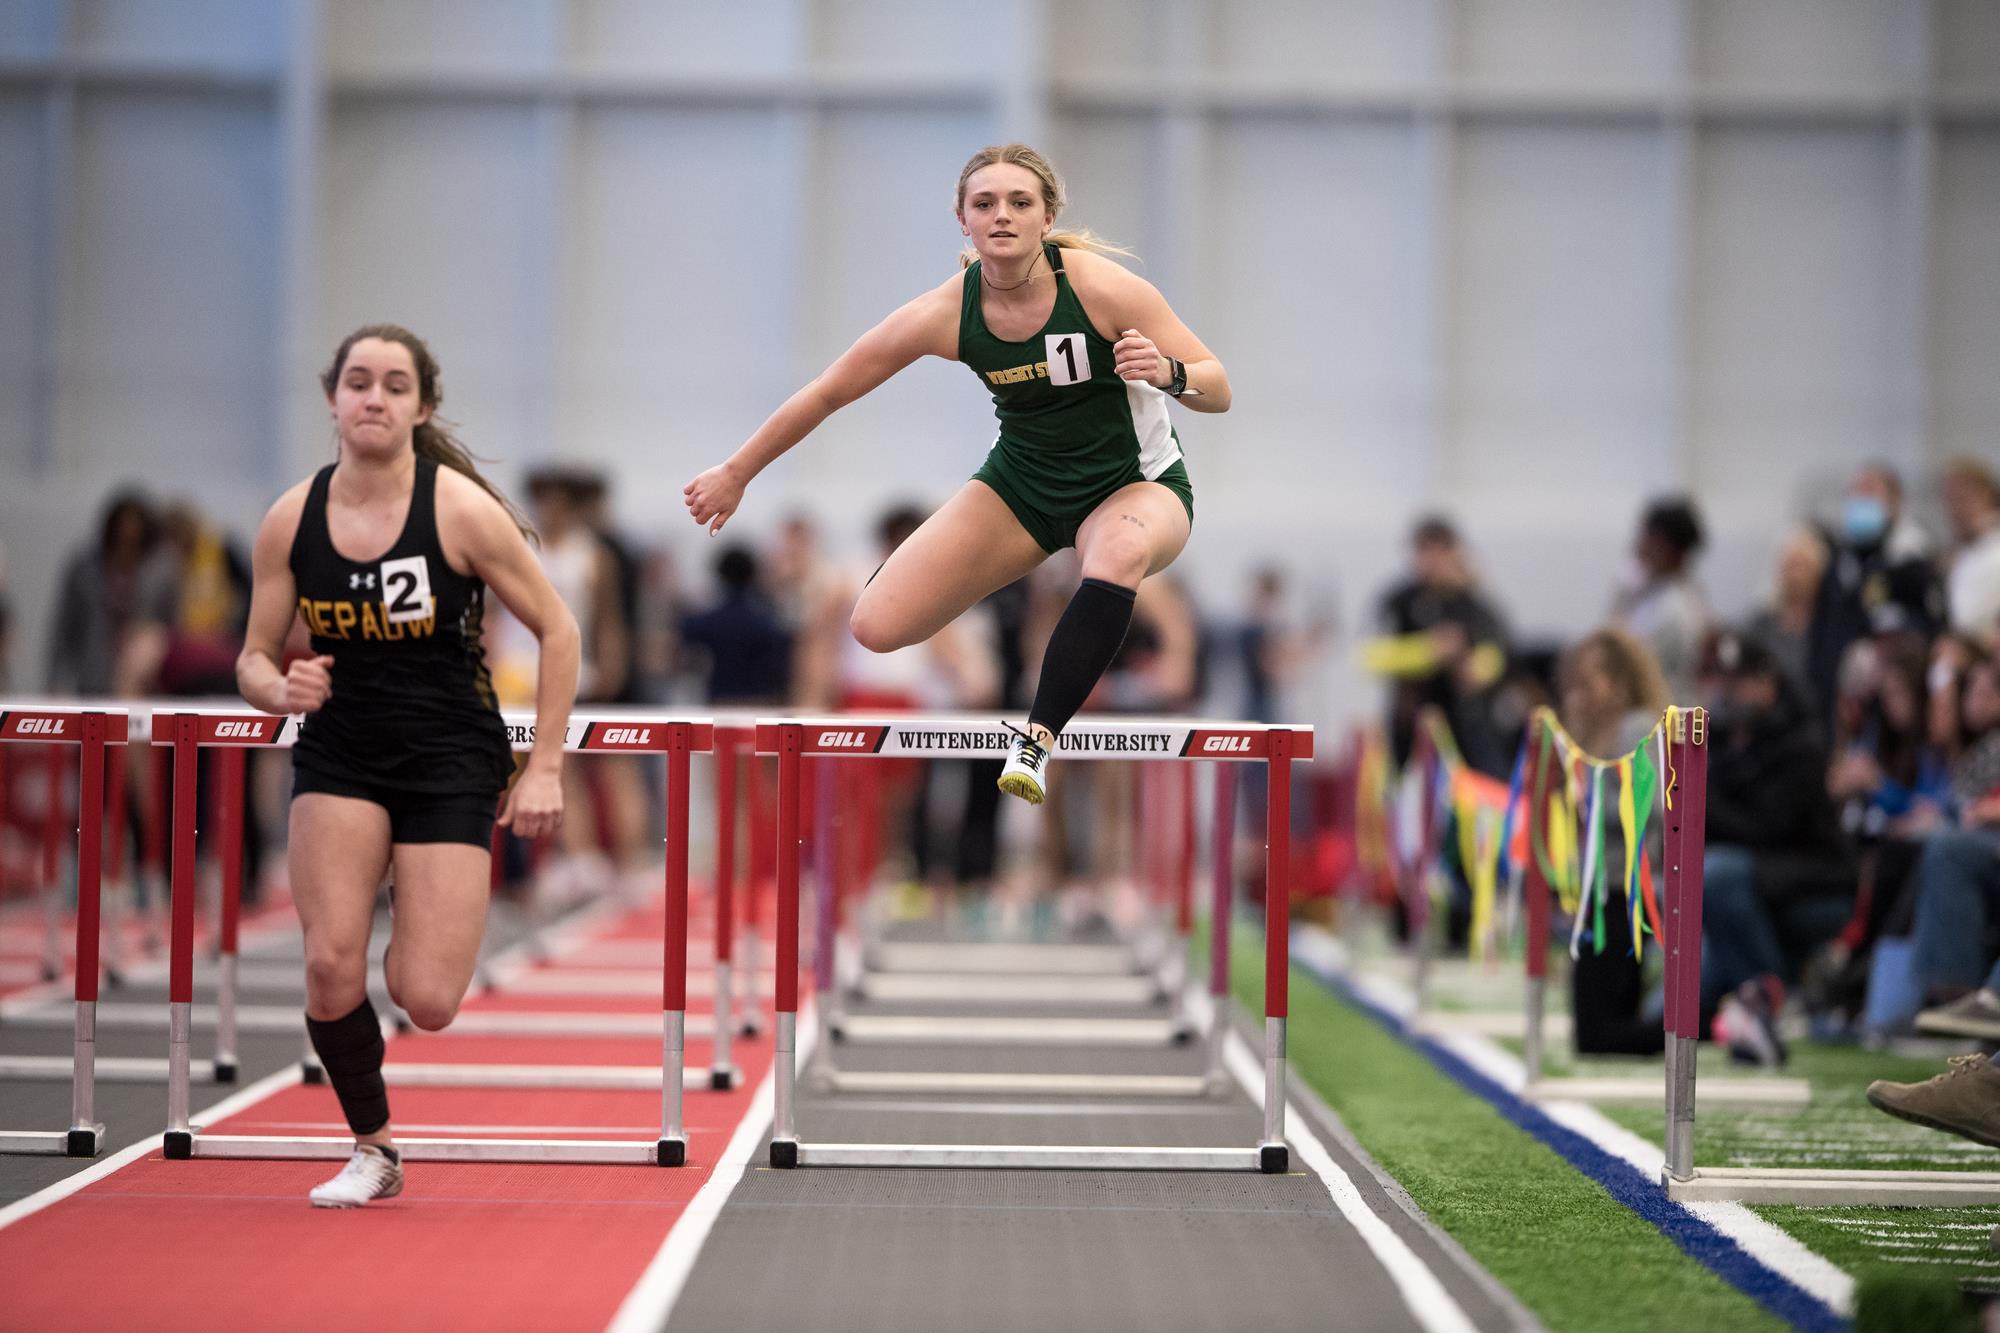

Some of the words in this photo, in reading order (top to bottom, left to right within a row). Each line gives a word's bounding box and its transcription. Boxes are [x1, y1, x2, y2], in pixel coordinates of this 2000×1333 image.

[1055, 337, 1079, 382] 1
[386, 570, 423, 614] 2
[16, 718, 65, 735] GILL
[214, 721, 263, 738] GILL
[602, 728, 650, 744] GILL
[817, 731, 866, 748] GILL
[1057, 733, 1171, 752] UNIVERSITY
[1202, 736, 1252, 752] GILL
